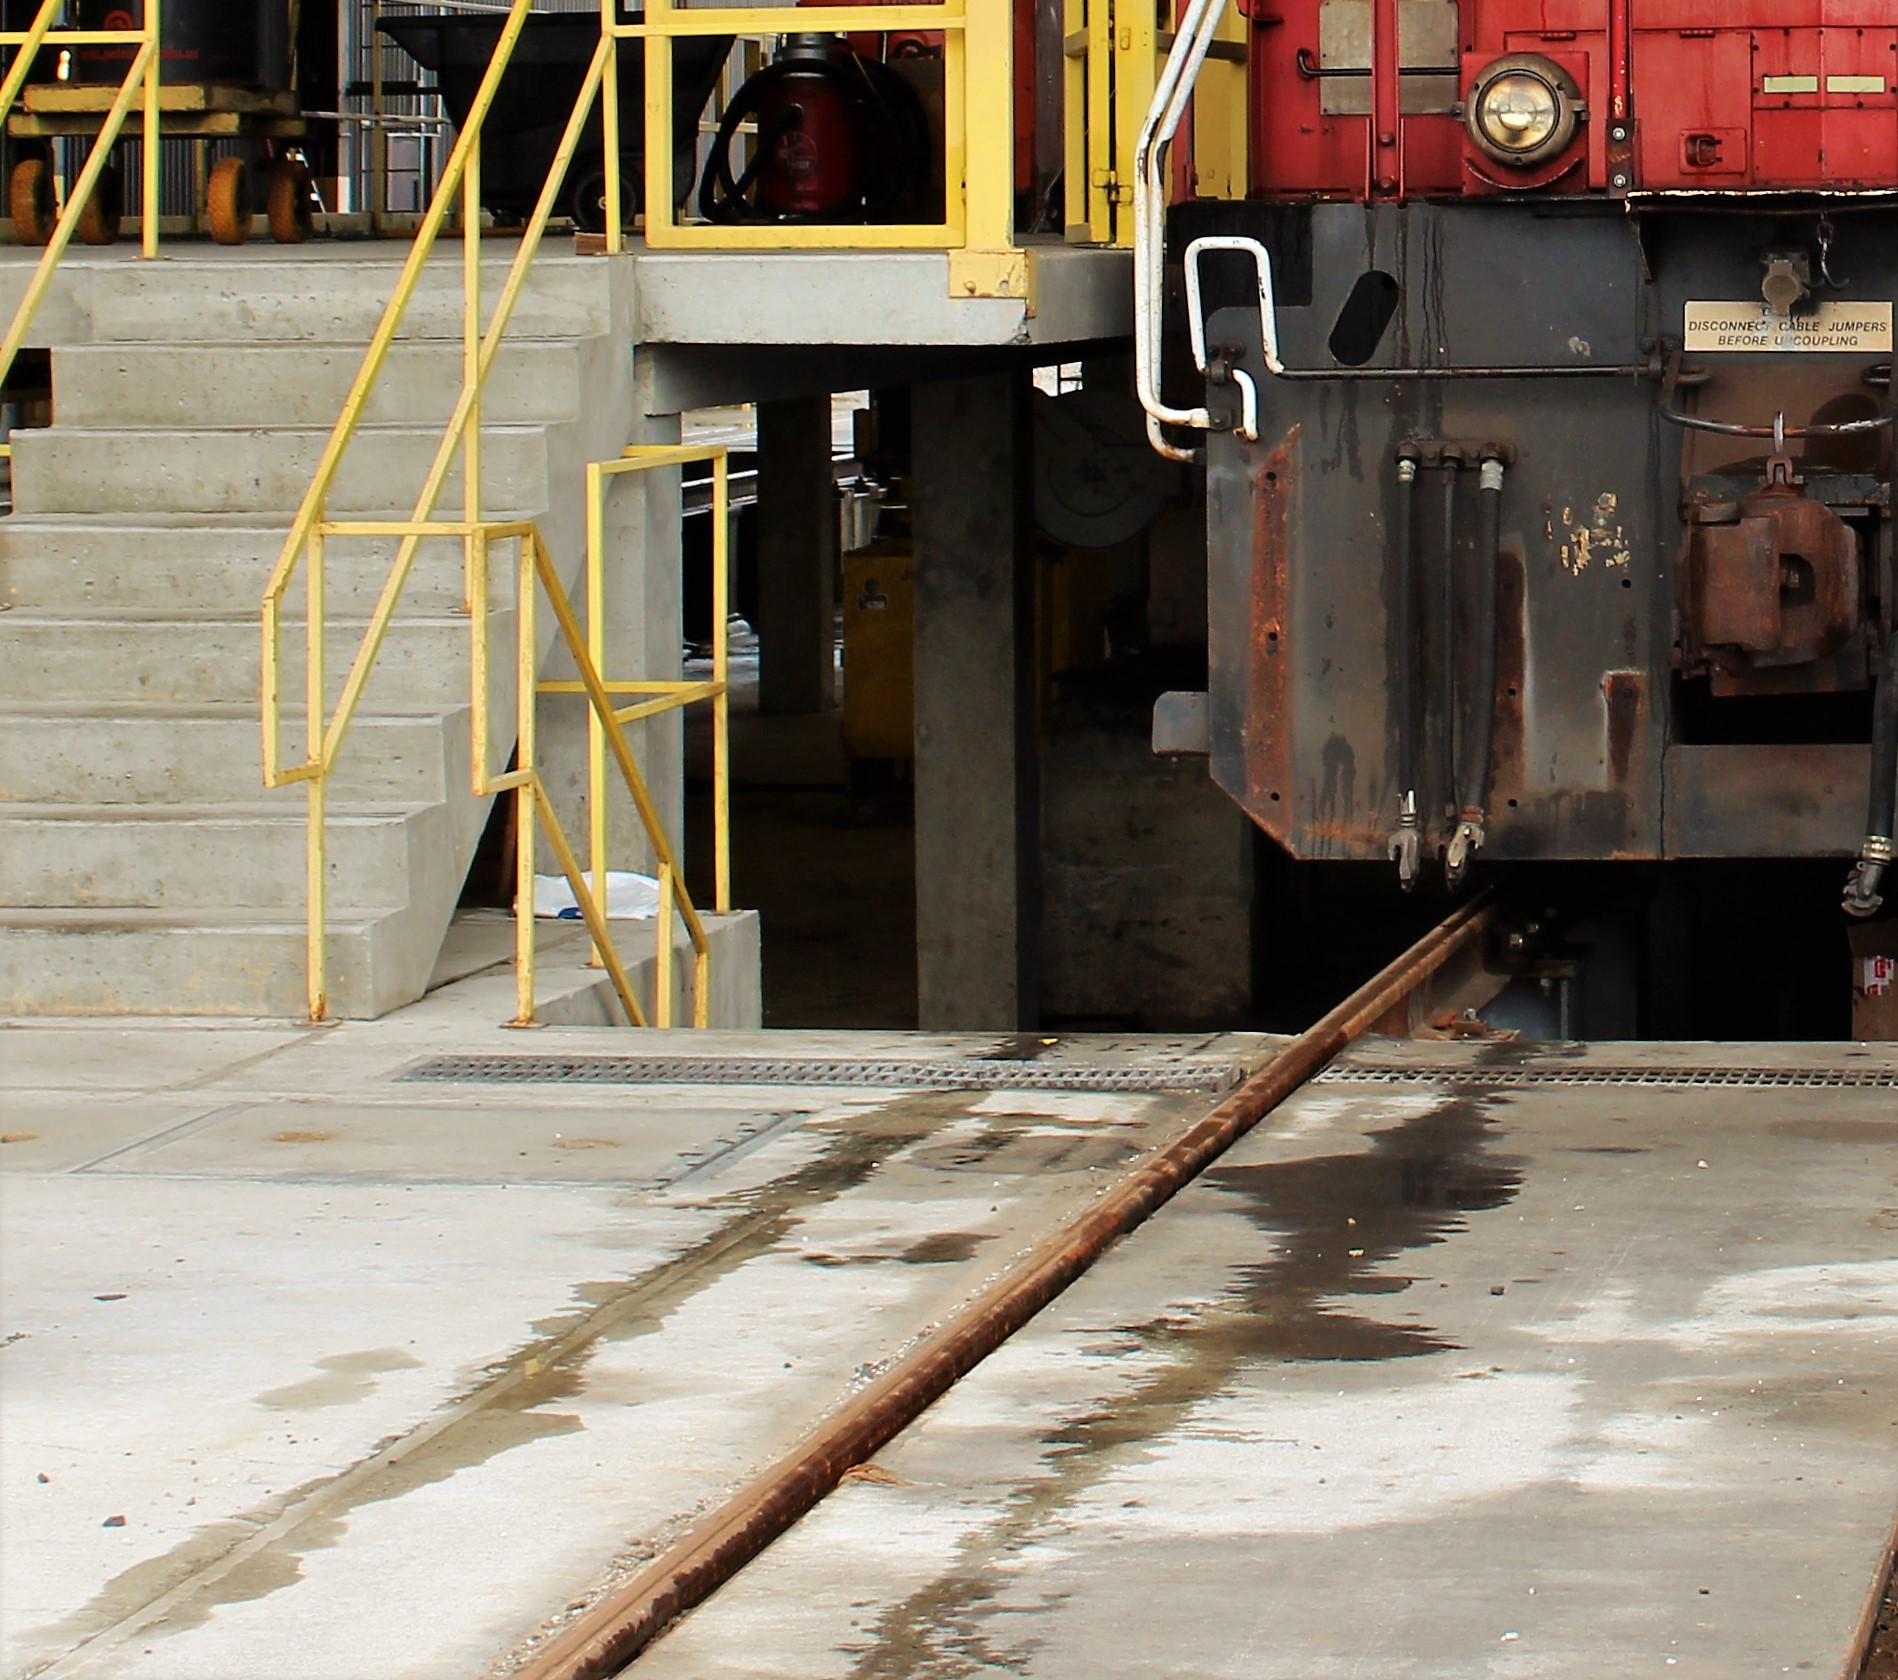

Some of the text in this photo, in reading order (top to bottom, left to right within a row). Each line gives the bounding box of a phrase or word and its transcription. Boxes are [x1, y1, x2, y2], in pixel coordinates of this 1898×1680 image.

[1778, 320, 1820, 332] CABLE
[1828, 320, 1887, 332] JUMPERS
[1718, 335, 1858, 346] BEFORE UCOUPLING
